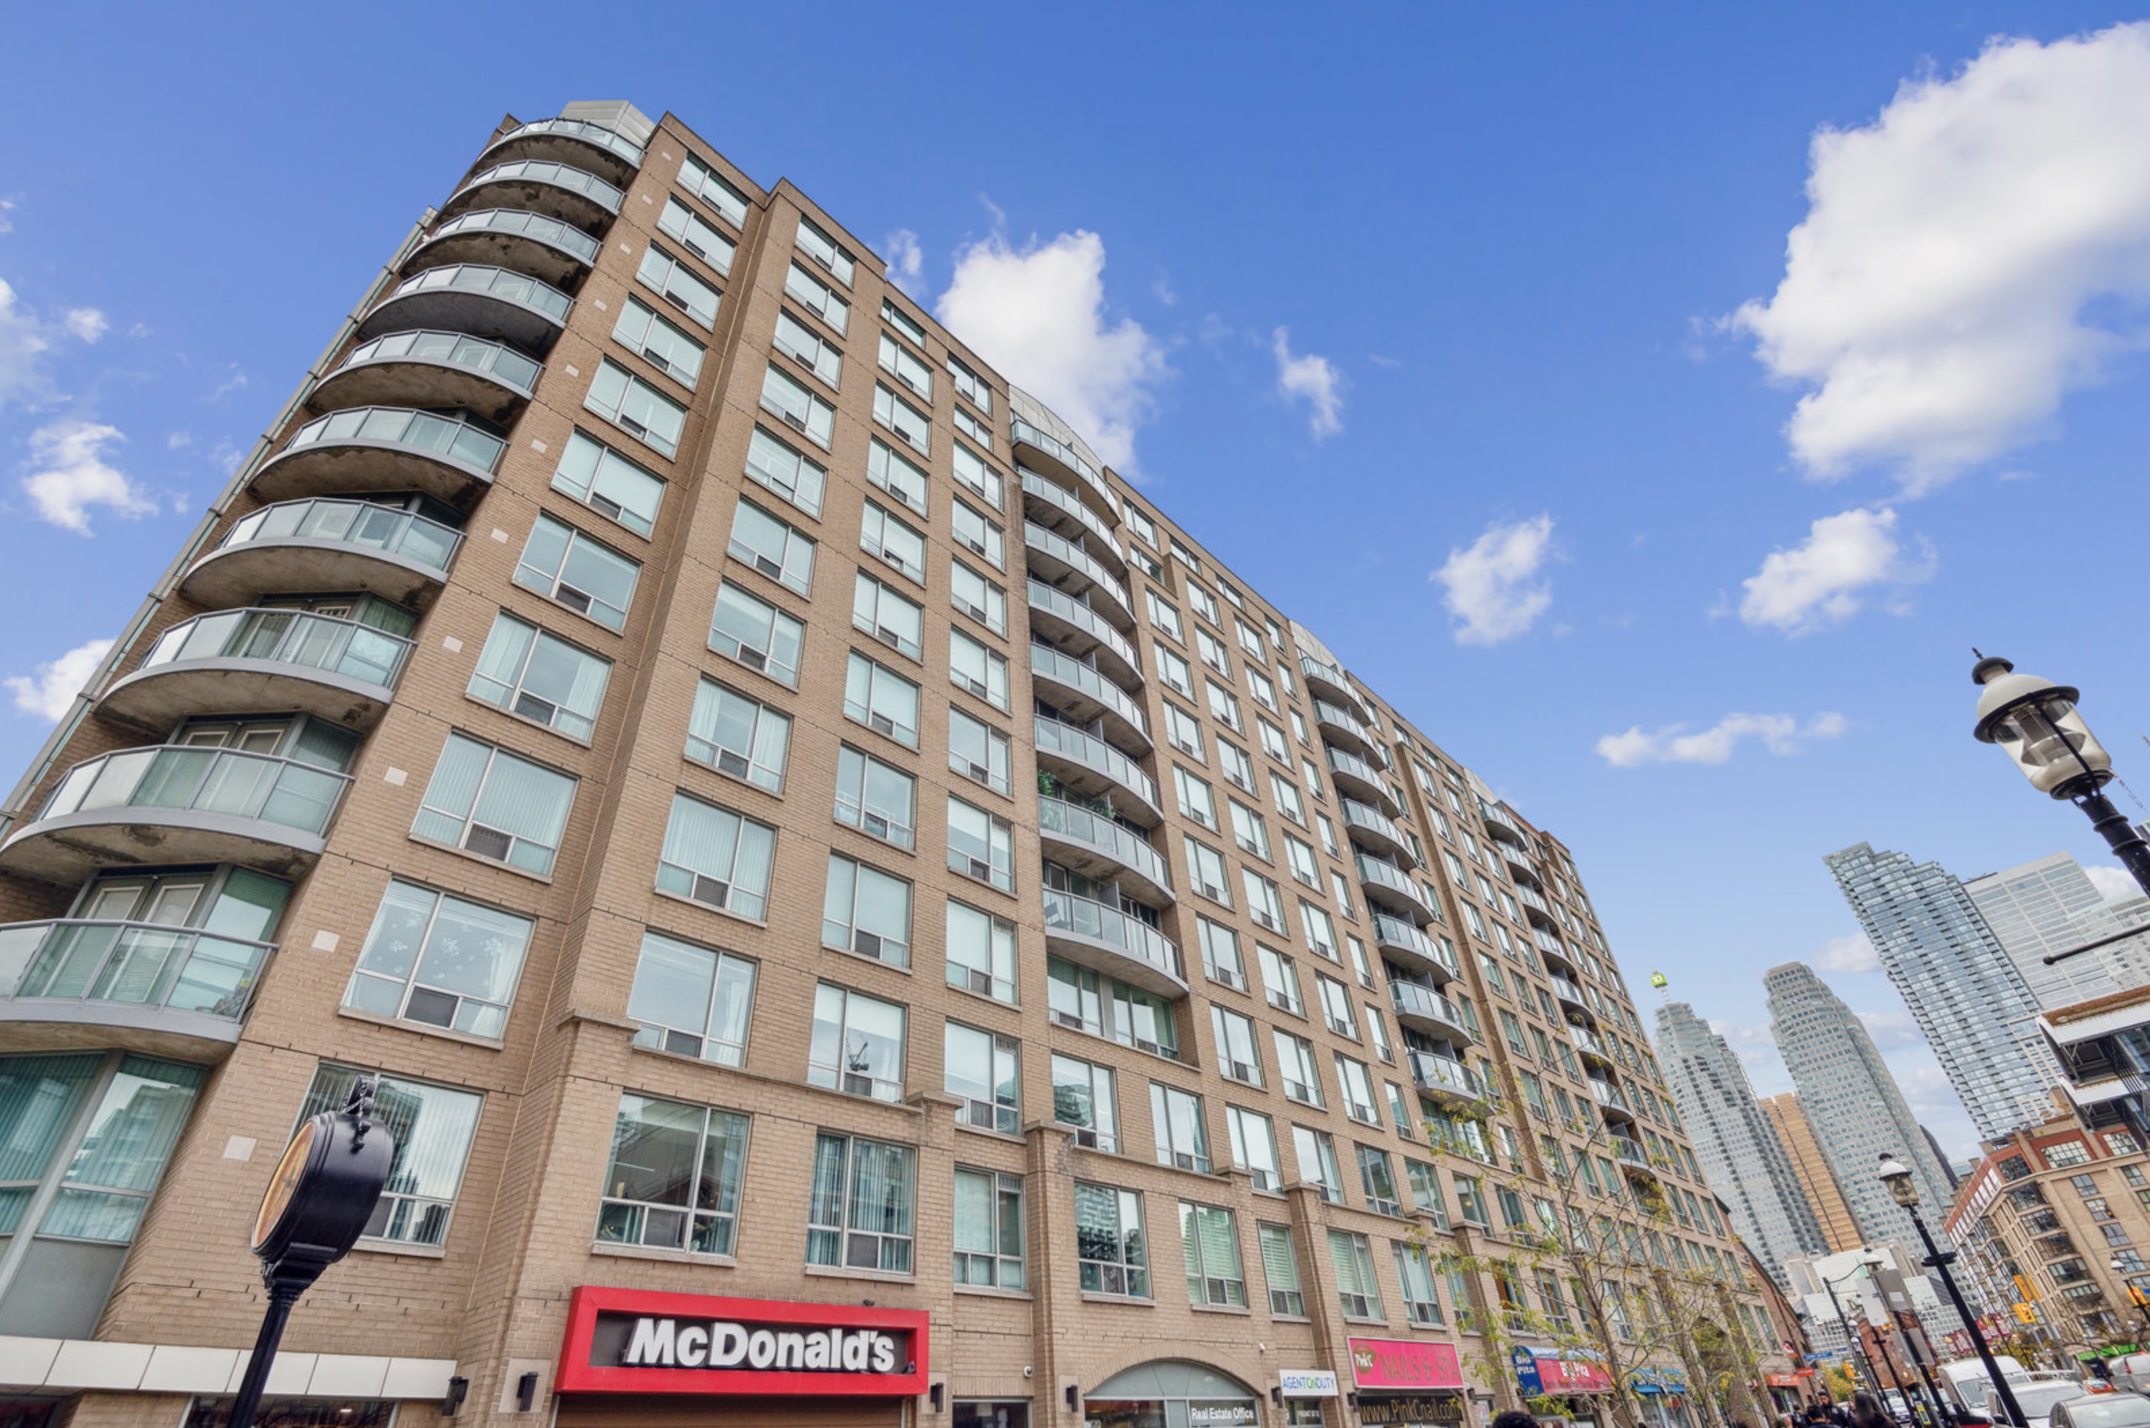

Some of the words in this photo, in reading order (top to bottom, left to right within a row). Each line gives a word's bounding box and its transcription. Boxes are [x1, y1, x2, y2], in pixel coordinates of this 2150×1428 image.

[626, 1317, 895, 1372] McDonald's
[1379, 1354, 1420, 1381] NAILS
[1422, 1356, 1433, 1381] &
[1436, 1355, 1461, 1381] SPA
[1516, 1366, 1535, 1375] Pita
[1191, 1408, 1209, 1420] Real
[1209, 1407, 1232, 1420] Estate
[1232, 1406, 1254, 1419] Office
